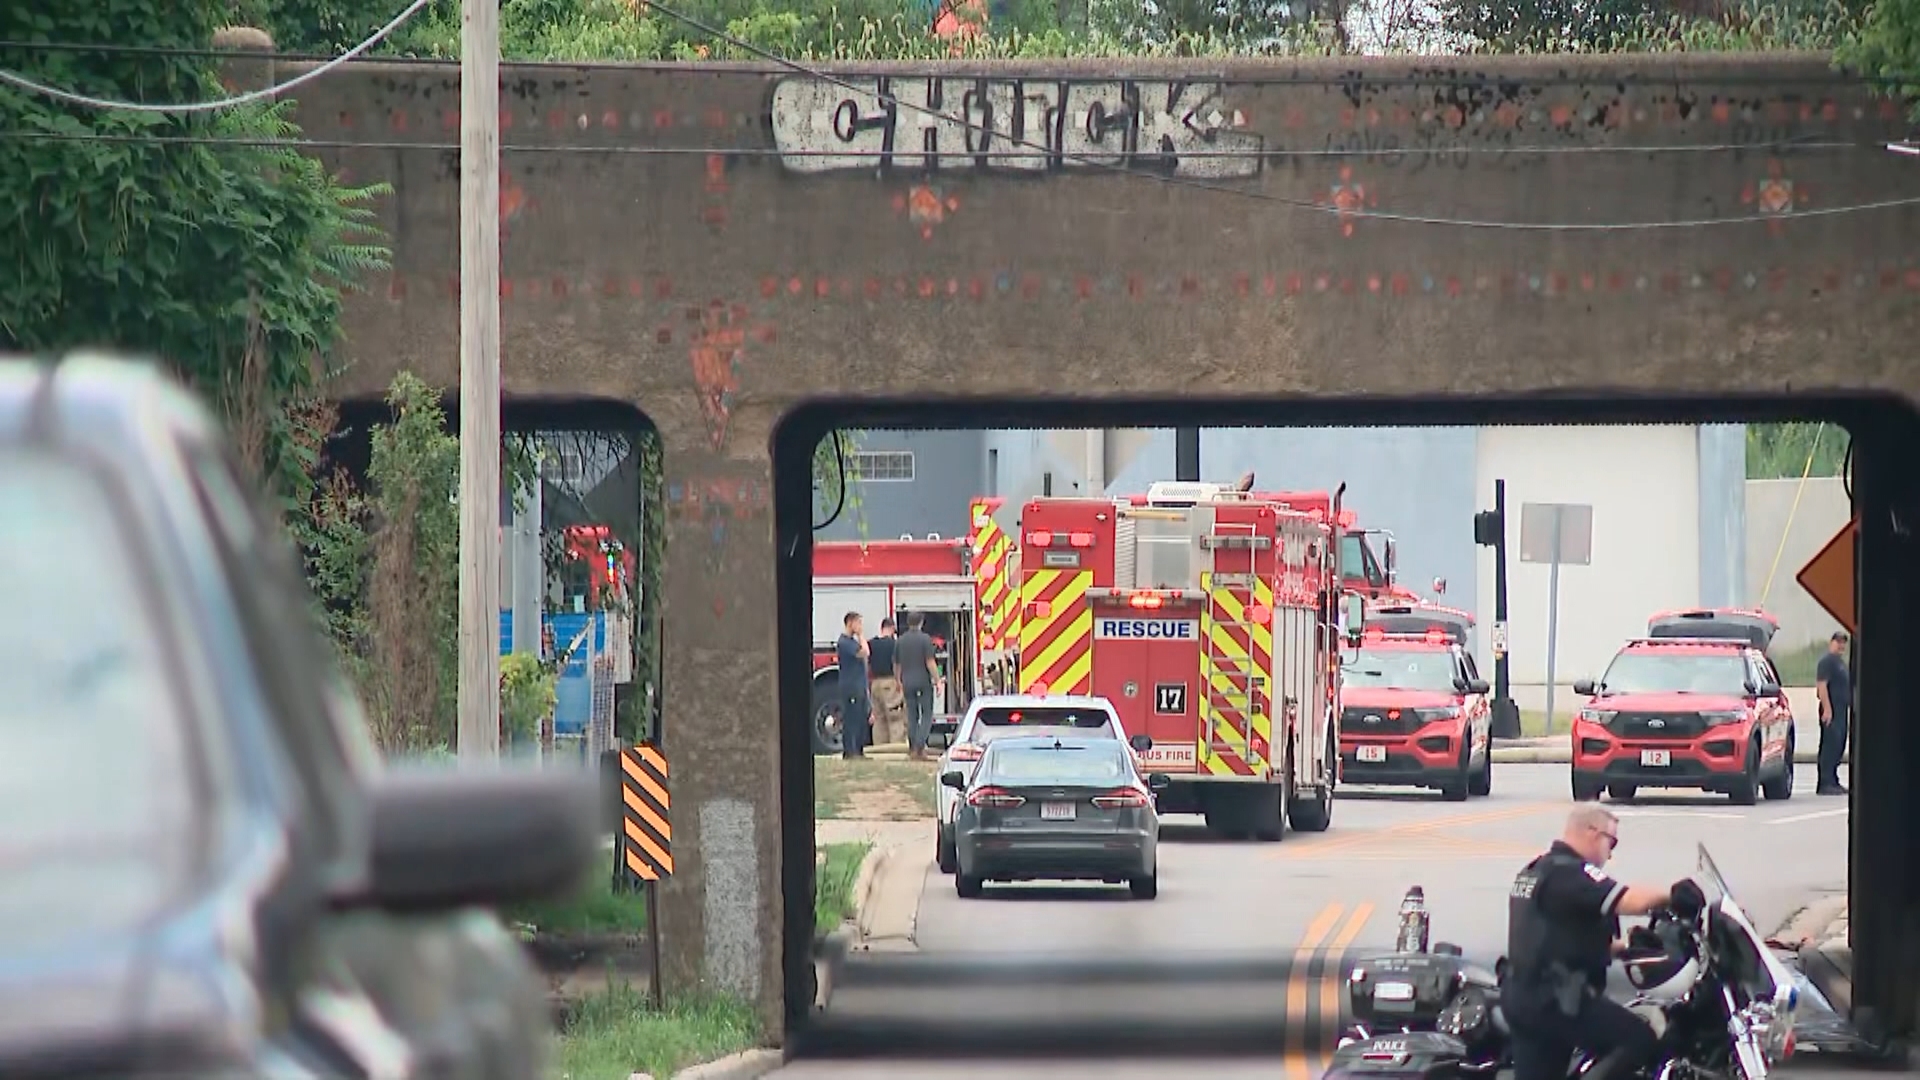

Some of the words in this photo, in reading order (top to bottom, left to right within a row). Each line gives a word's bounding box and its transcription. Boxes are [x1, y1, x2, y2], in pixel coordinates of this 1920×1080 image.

[769, 75, 1262, 180] CHUCK
[1103, 620, 1191, 639] RESCUE
[1159, 688, 1182, 710] 17
[1166, 750, 1192, 761] FIRE
[1373, 1039, 1408, 1052] POLICE
